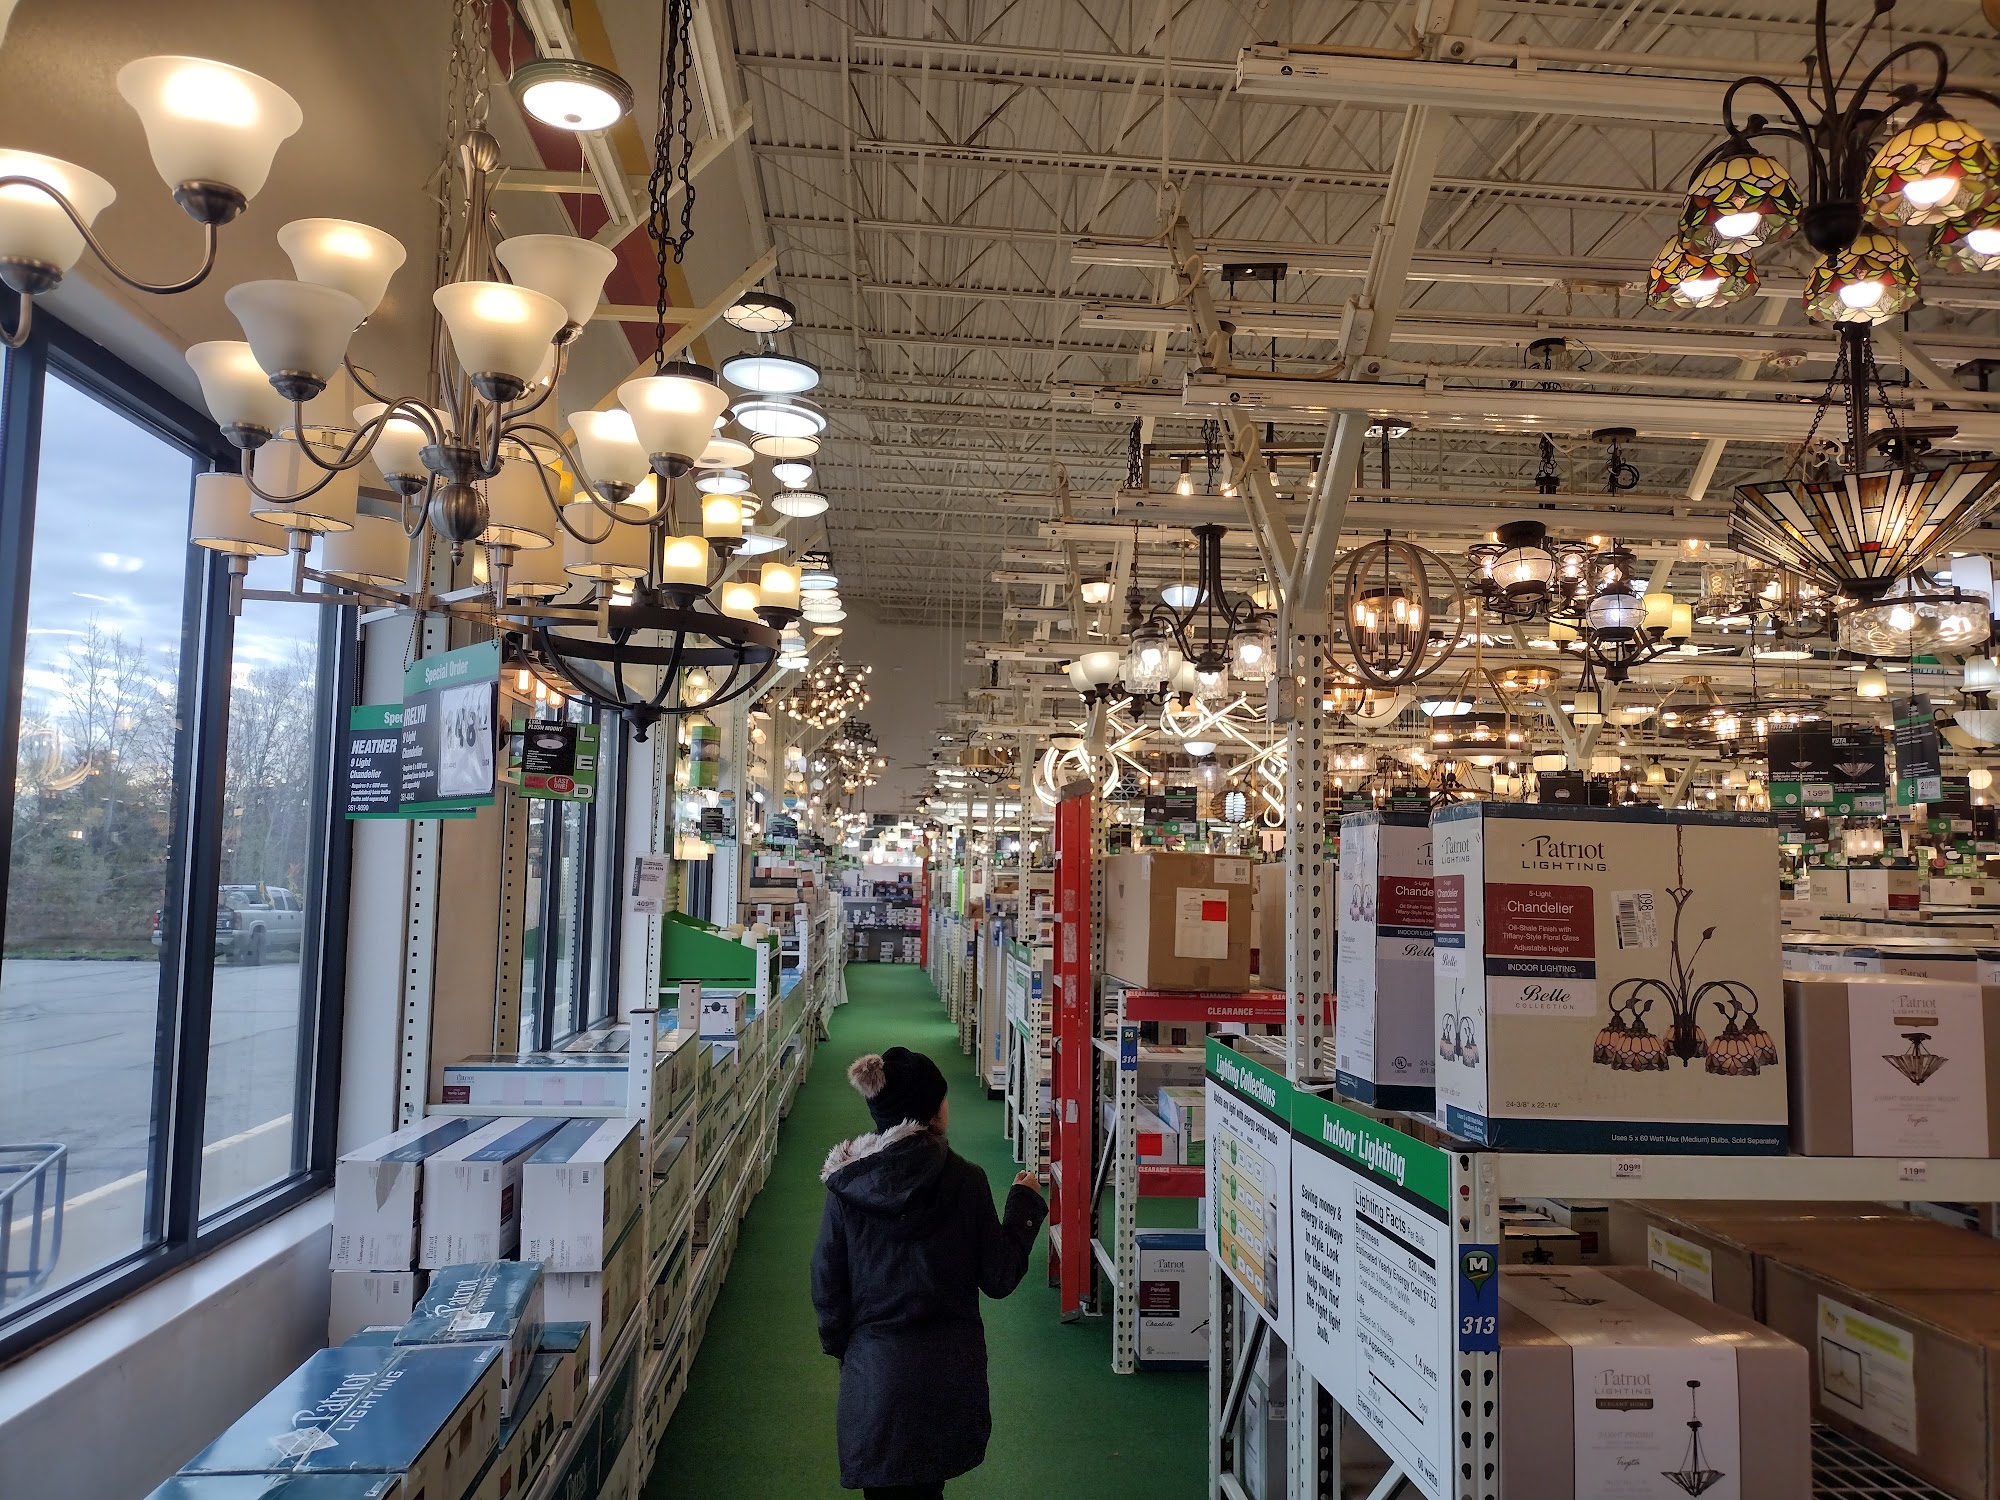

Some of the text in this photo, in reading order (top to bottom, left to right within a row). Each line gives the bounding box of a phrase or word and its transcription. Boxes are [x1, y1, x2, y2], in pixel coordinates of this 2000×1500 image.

[425, 660, 469, 685] Special Order
[403, 704, 428, 727] IRELYN
[351, 739, 398, 755] HEATHER
[350, 757, 371, 768] 9 Light
[350, 769, 381, 779] Chandelier
[1739, 815, 1769, 823] 352-5990
[1443, 837, 1470, 855] Patriot
[1527, 835, 1606, 860] Patriot
[1441, 856, 1470, 864] LIGHTING
[1522, 861, 1608, 872] LIGHTING
[1395, 886, 1434, 897] Chande
[1437, 888, 1459, 898] Chandelier
[1528, 890, 1551, 898] 5-Light
[1507, 900, 1574, 914] Chandelier
[1503, 933, 1542, 941] Tiffany-Style
[1562, 934, 1580, 942] Glass
[1508, 924, 1537, 932] Oil-Shale
[1513, 944, 1570, 953] Adjustable Height
[1507, 963, 1576, 973] INDOOR LIGHTING
[1520, 984, 1571, 1003] Belle
[1897, 994, 1937, 1009] Patriot
[1207, 1007, 1253, 1016] CLEARANCE
[1515, 1002, 1574, 1010] COLLECTION
[1122, 1055, 1136, 1064] 314
[1216, 1053, 1275, 1108] Lighting Collections
[1236, 1108, 1244, 1121] with
[1244, 1114, 1255, 1132] energy
[1256, 1122, 1267, 1140] saving
[1267, 1128, 1277, 1146] bulbs
[1611, 1134, 1628, 1142] Uses
[1680, 1135, 1709, 1144] (Medium)
[1747, 1137, 1780, 1146] Separately
[1323, 1114, 1406, 1187] Indoor Lighting
[1301, 1184, 1342, 1221] Saving money &
[1300, 1207, 1343, 1245] energy is always
[1355, 1188, 1425, 1247] Lighting Facts Per Bulb
[1356, 1222, 1379, 1246] Brightness
[337, 1236, 346, 1260] Patriot
[426, 1236, 434, 1260] Patriot
[1305, 1227, 1339, 1264] in style. Look
[1157, 1259, 1185, 1268] Patriot
[1312, 1254, 1320, 1272] the
[1321, 1261, 1334, 1283] label
[1335, 1271, 1341, 1288] to
[1359, 1260, 1370, 1275] Based
[1408, 1258, 1437, 1287] 820 lumens
[1468, 1257, 1489, 1272] M
[1356, 1242, 1437, 1309] Estimated Yearly Energy Cost $7.23
[434, 1278, 481, 1317] Patriot
[471, 1277, 498, 1313] IGHTING
[1306, 1271, 1339, 1309] help you find
[1356, 1291, 1365, 1306] Life
[1359, 1274, 1367, 1288] Cost
[1368, 1282, 1383, 1301] depends
[1389, 1299, 1399, 1313] rates
[1399, 1307, 1407, 1319] and
[1407, 1314, 1416, 1327] use
[1306, 1291, 1341, 1333] the right light
[1359, 1308, 1370, 1325] Based
[1317, 1322, 1330, 1345] bulb.
[1461, 1316, 1496, 1335] 313
[1356, 1326, 1395, 1368] Light Appearance
[1363, 1348, 1375, 1364] Warm
[1414, 1353, 1438, 1383] 1.4 years
[1600, 1369, 1652, 1386] Patriot
[291, 1371, 378, 1428] Patriot
[335, 1370, 405, 1431] LIGHTING
[1418, 1397, 1429, 1415] Cool
[1357, 1395, 1384, 1429] Energy Used
[1417, 1456, 1438, 1488] 60 watts
